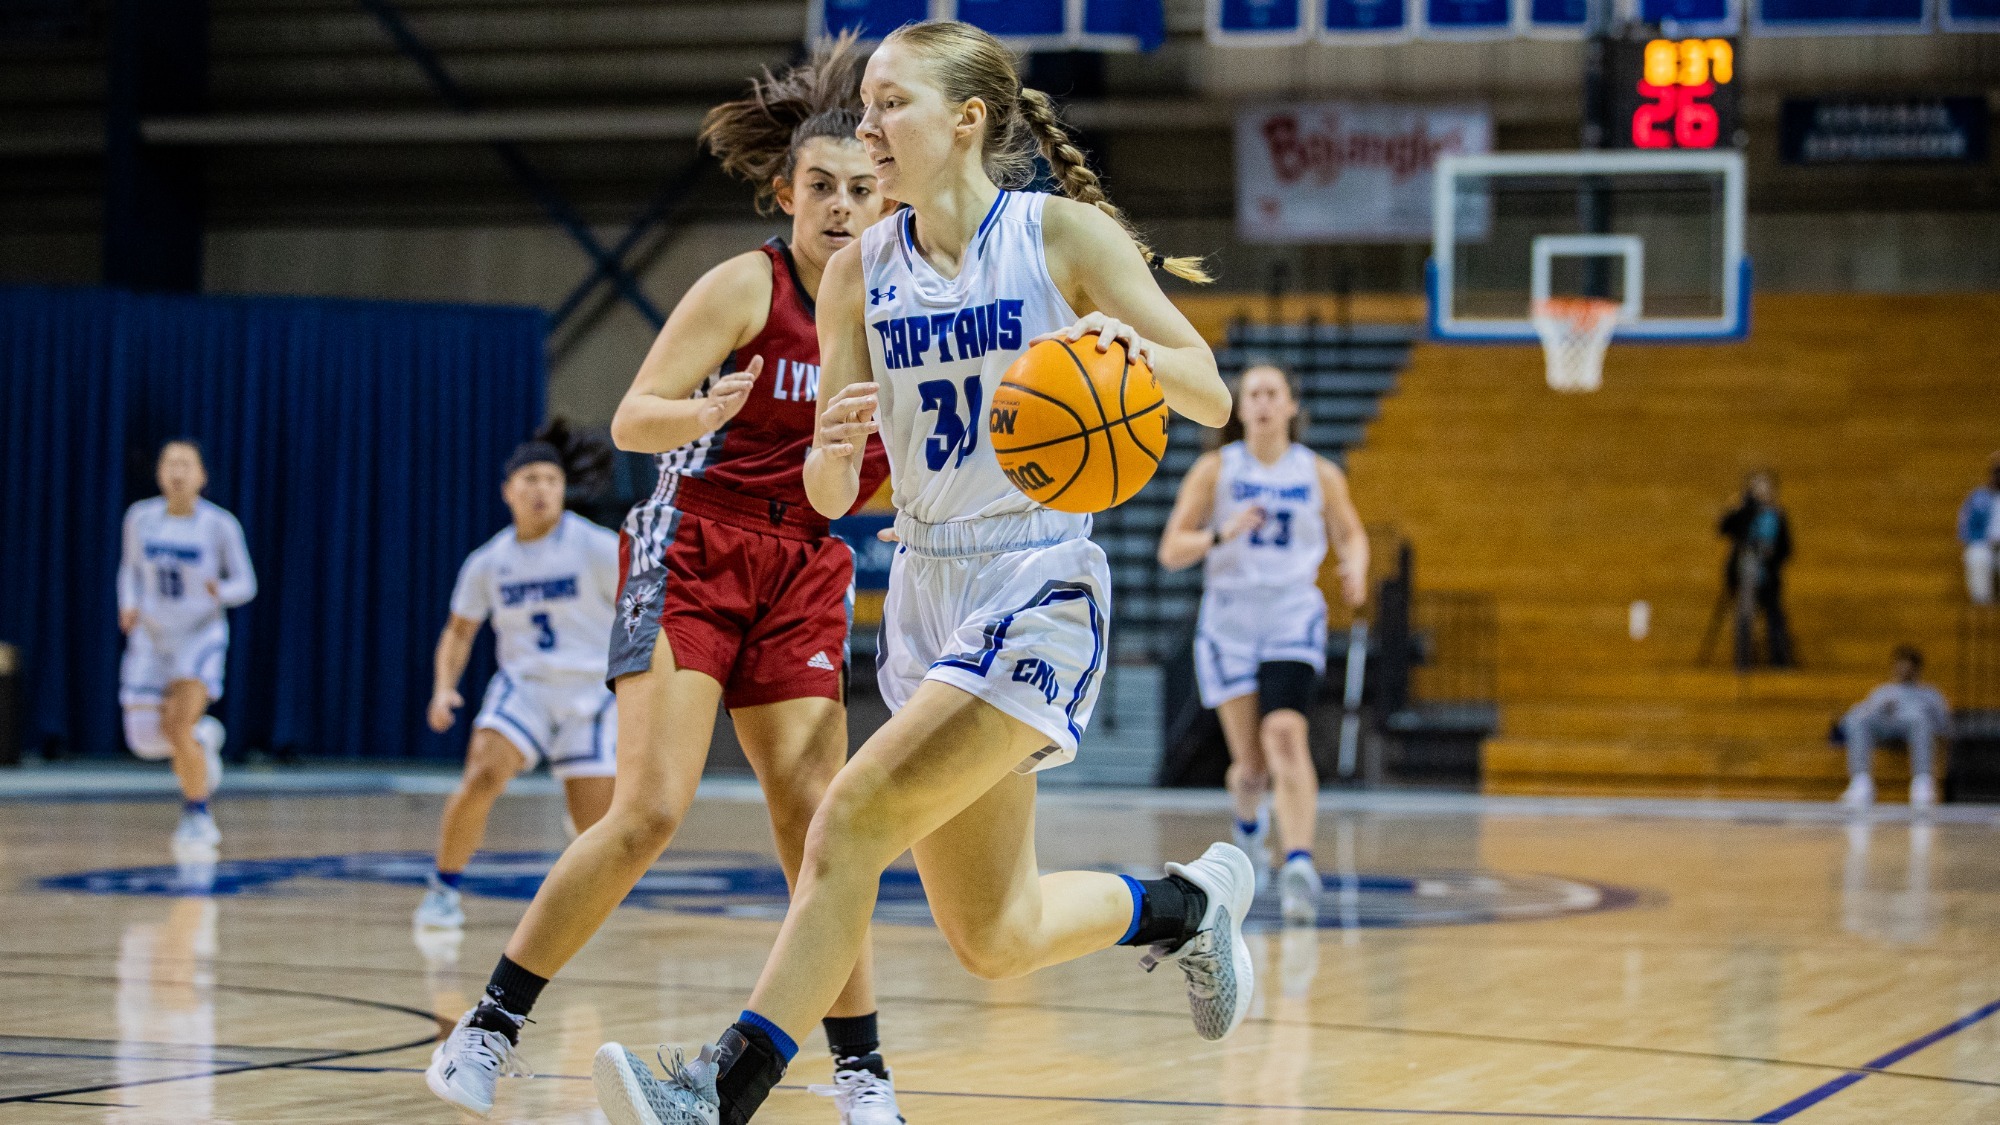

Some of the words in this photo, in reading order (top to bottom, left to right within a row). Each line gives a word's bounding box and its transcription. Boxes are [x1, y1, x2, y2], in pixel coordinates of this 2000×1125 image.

[1632, 78, 1719, 149] 26
[872, 298, 1024, 370] CAPTAINS
[530, 611, 556, 652] 3
[1011, 657, 1060, 706] CNU
